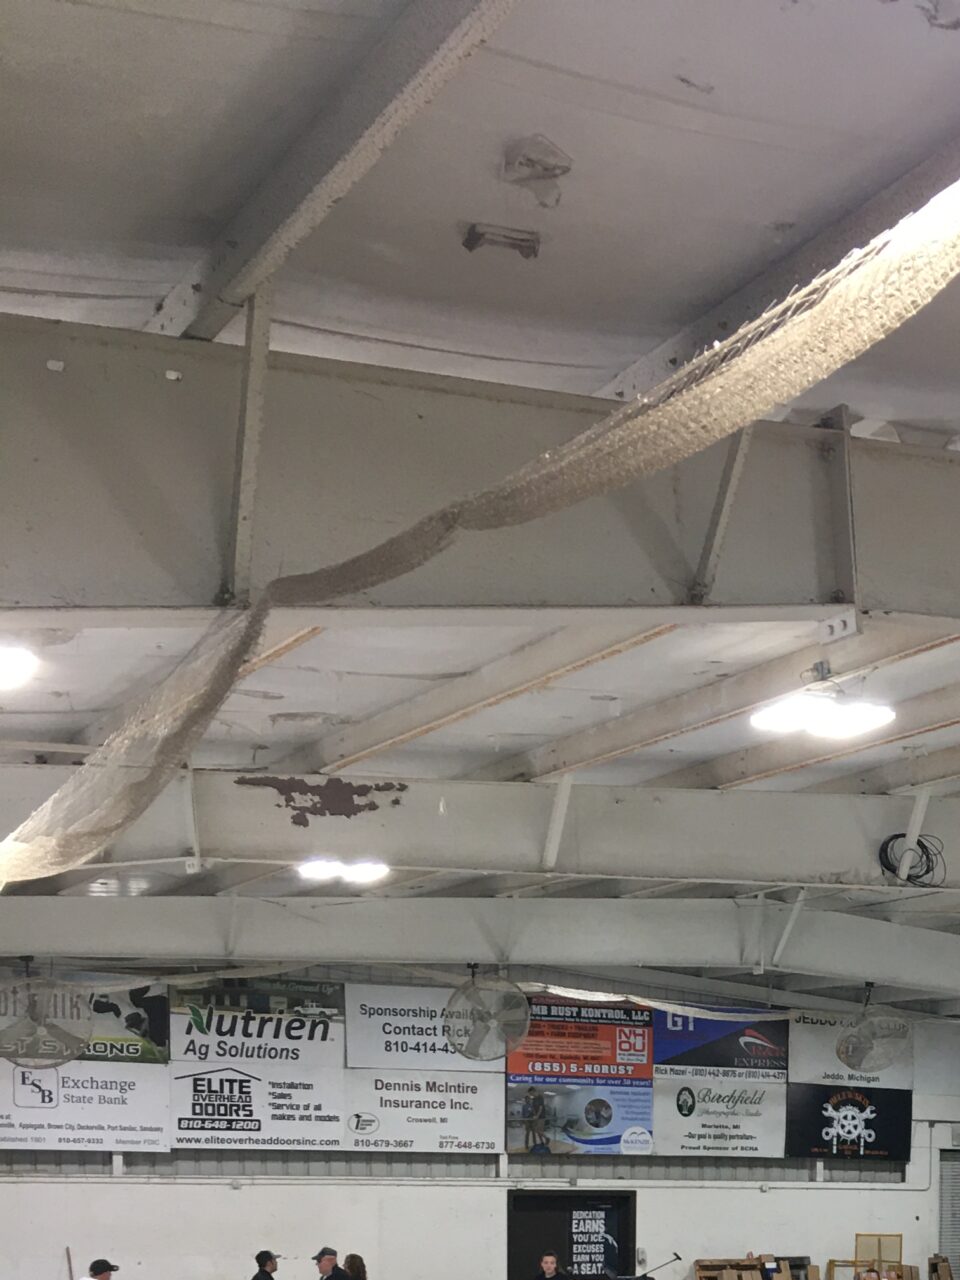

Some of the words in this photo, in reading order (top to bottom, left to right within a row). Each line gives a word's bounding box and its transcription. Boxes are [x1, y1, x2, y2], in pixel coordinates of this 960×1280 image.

[360, 1004, 437, 1021] Sponsorship
[551, 1006, 579, 1017] RUST
[580, 1007, 628, 1021] KONTROL,
[631, 1010, 650, 1022] LLC
[185, 1003, 330, 1042] Nutrien
[382, 1022, 438, 1037] Contact
[442, 1024, 471, 1039] Rick
[184, 1040, 209, 1061] Ag
[216, 1041, 300, 1061] Solutions
[734, 1057, 787, 1068] EXPRESS
[528, 1062, 567, 1074] (855)
[570, 1064, 634, 1076] 5-NORUST
[655, 1066, 667, 1076] Rick
[510, 1074, 532, 1084] Caring
[534, 1075, 544, 1083] for
[558, 1077, 594, 1085] community
[848, 1073, 880, 1084] Michigan
[61, 1076, 136, 1093] Exchange
[193, 1077, 251, 1094] ELITE
[374, 1079, 421, 1093] Dennis
[425, 1081, 478, 1096] McIntire
[63, 1093, 94, 1105] State
[98, 1095, 128, 1106] Bank
[192, 1094, 252, 1104] OVERHEAD
[379, 1096, 447, 1111] Insurance
[450, 1098, 473, 1112] Inc.
[697, 1087, 766, 1110] Birchfield
[191, 1103, 253, 1117] DOORS
[303, 1104, 311, 1112] of
[313, 1104, 322, 1112] all
[271, 1113, 296, 1121] makes
[298, 1114, 312, 1122] and
[314, 1115, 340, 1124] models
[180, 1119, 260, 1131] 810-648-1200
[176, 1136, 340, 1146] www.eliteoverheaddoorsinc.com
[354, 1139, 414, 1149] 810-679-3667
[438, 1140, 495, 1151] 877-648-6730
[573, 1210, 606, 1220] DEDICATION
[572, 1220, 605, 1233] EARNS
[573, 1234, 590, 1243] YOU
[573, 1244, 604, 1254] EXCUSES
[573, 1254, 589, 1263] EARN
[591, 1254, 604, 1263] YOU
[573, 1264, 580, 1275] A
[581, 1264, 605, 1275] SEAT.
